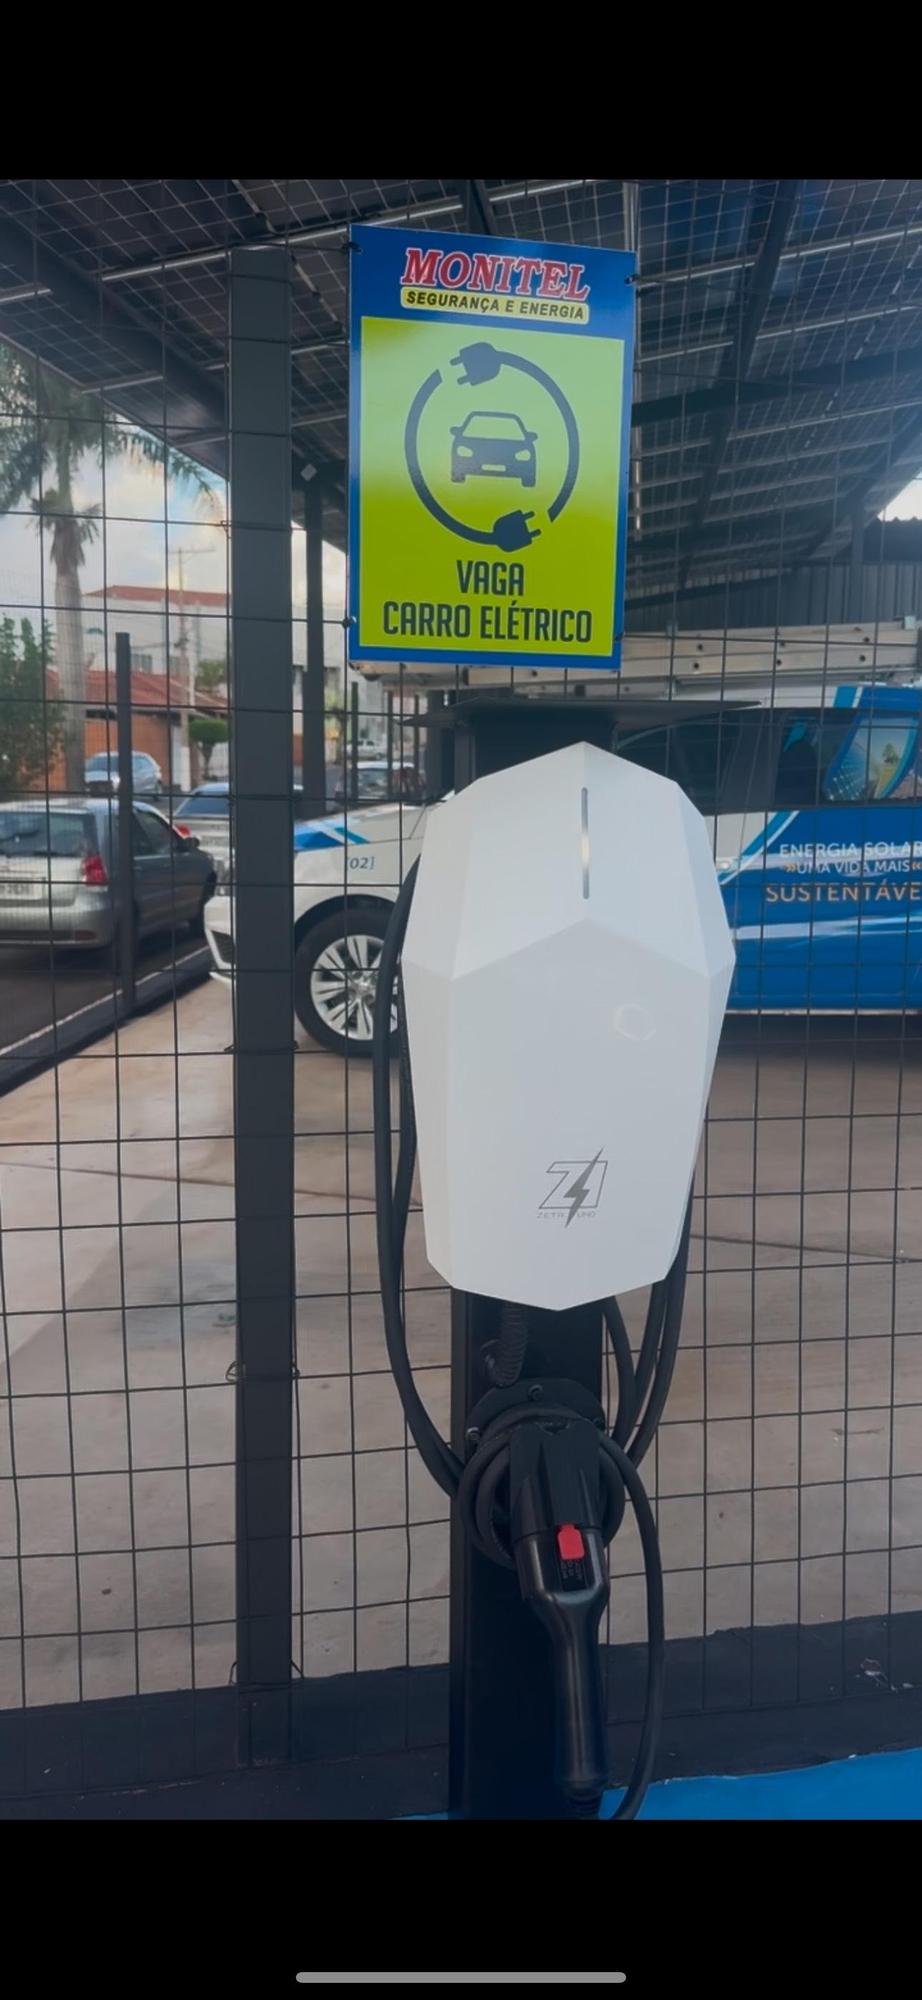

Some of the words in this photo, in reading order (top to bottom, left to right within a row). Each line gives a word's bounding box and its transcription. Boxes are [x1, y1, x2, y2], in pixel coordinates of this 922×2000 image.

[401, 248, 590, 301] MONITEL
[406, 291, 499, 314] SEGURANÇA
[505, 301, 515, 313] E
[520, 302, 585, 320] ENERGIA
[456, 560, 525, 596] VAGA
[383, 601, 471, 638] CARRO
[480, 600, 592, 643] ELÉTRICO
[780, 842, 857, 858] ENERGIA
[864, 841, 922, 857] SOLAR
[834, 861, 871, 874] VIDA
